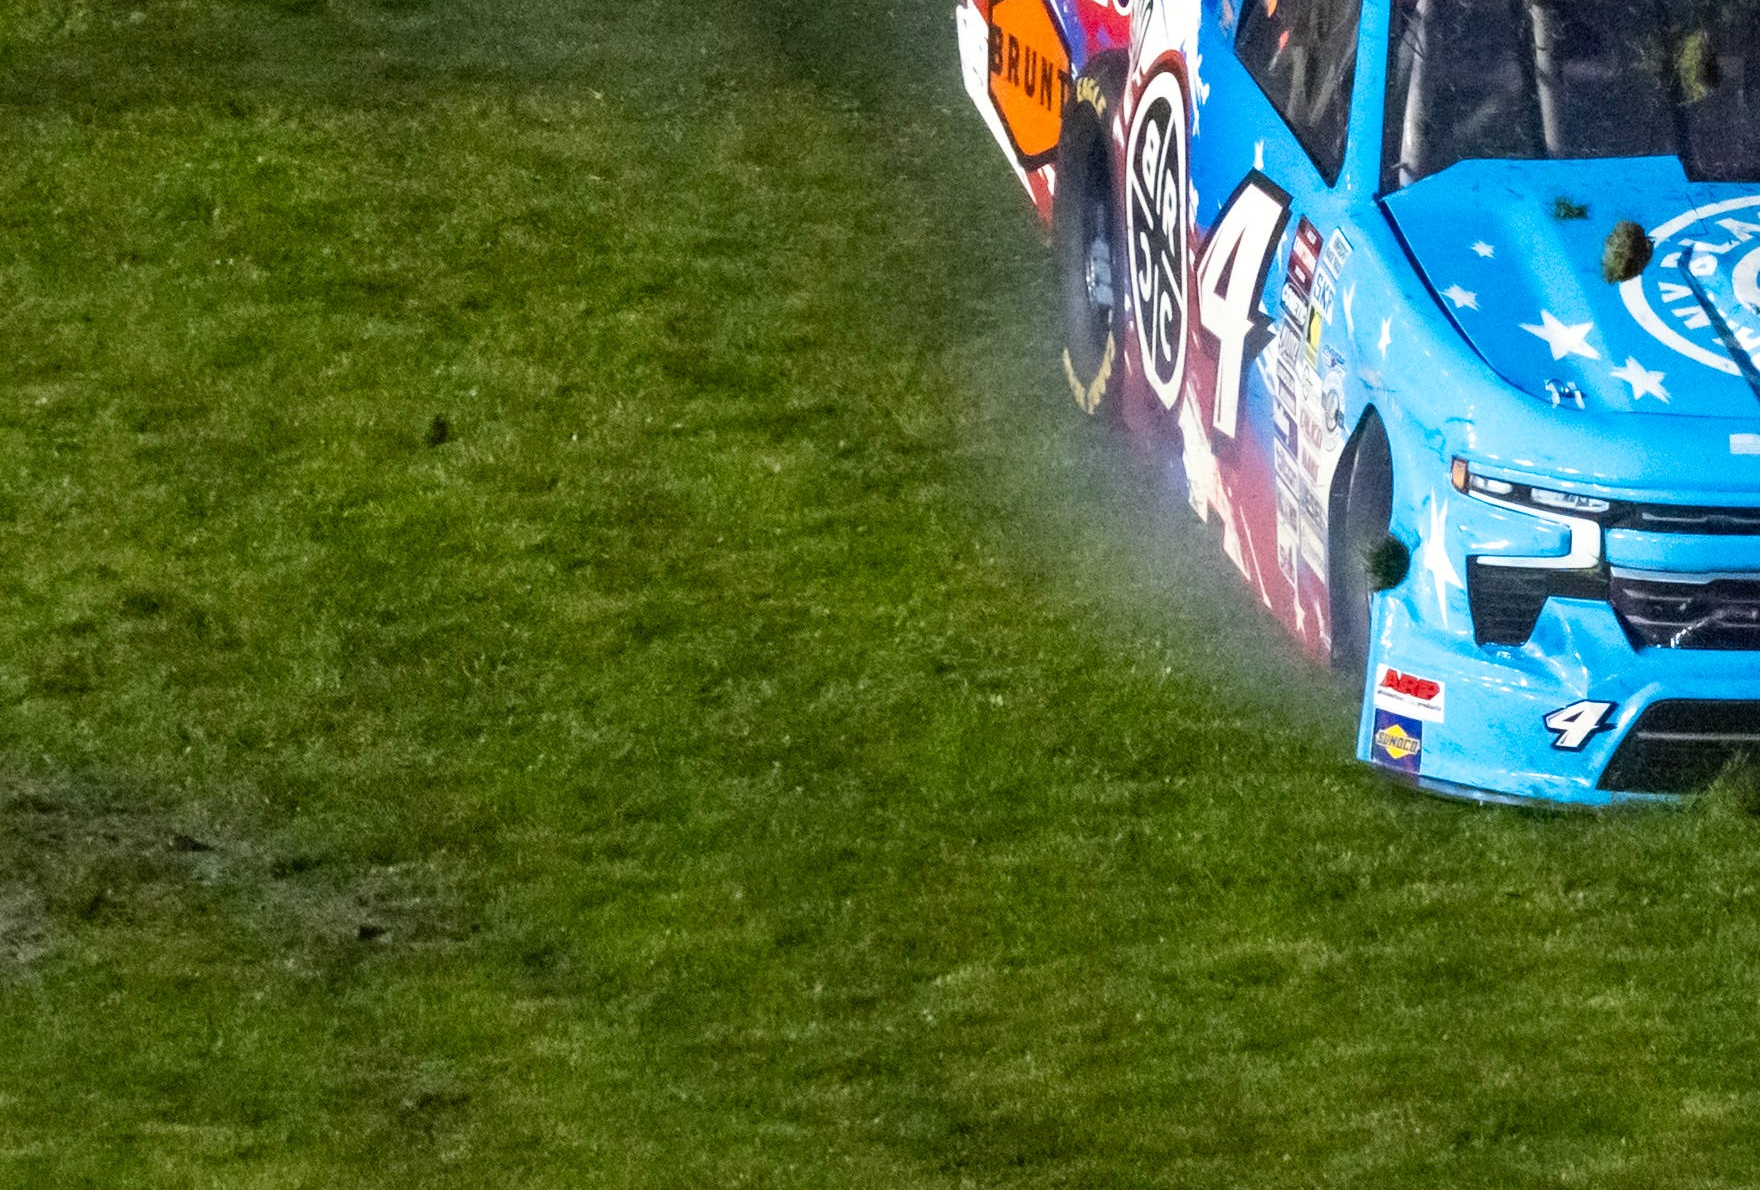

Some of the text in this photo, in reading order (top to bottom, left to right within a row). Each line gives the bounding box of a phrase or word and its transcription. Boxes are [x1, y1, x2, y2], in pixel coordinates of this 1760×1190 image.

[989, 24, 1071, 114] BRUNT
[1196, 176, 1288, 446] 4
[1380, 668, 1440, 701] ARP
[1377, 731, 1419, 753] SUNOCO
[1544, 700, 1616, 750] 4
